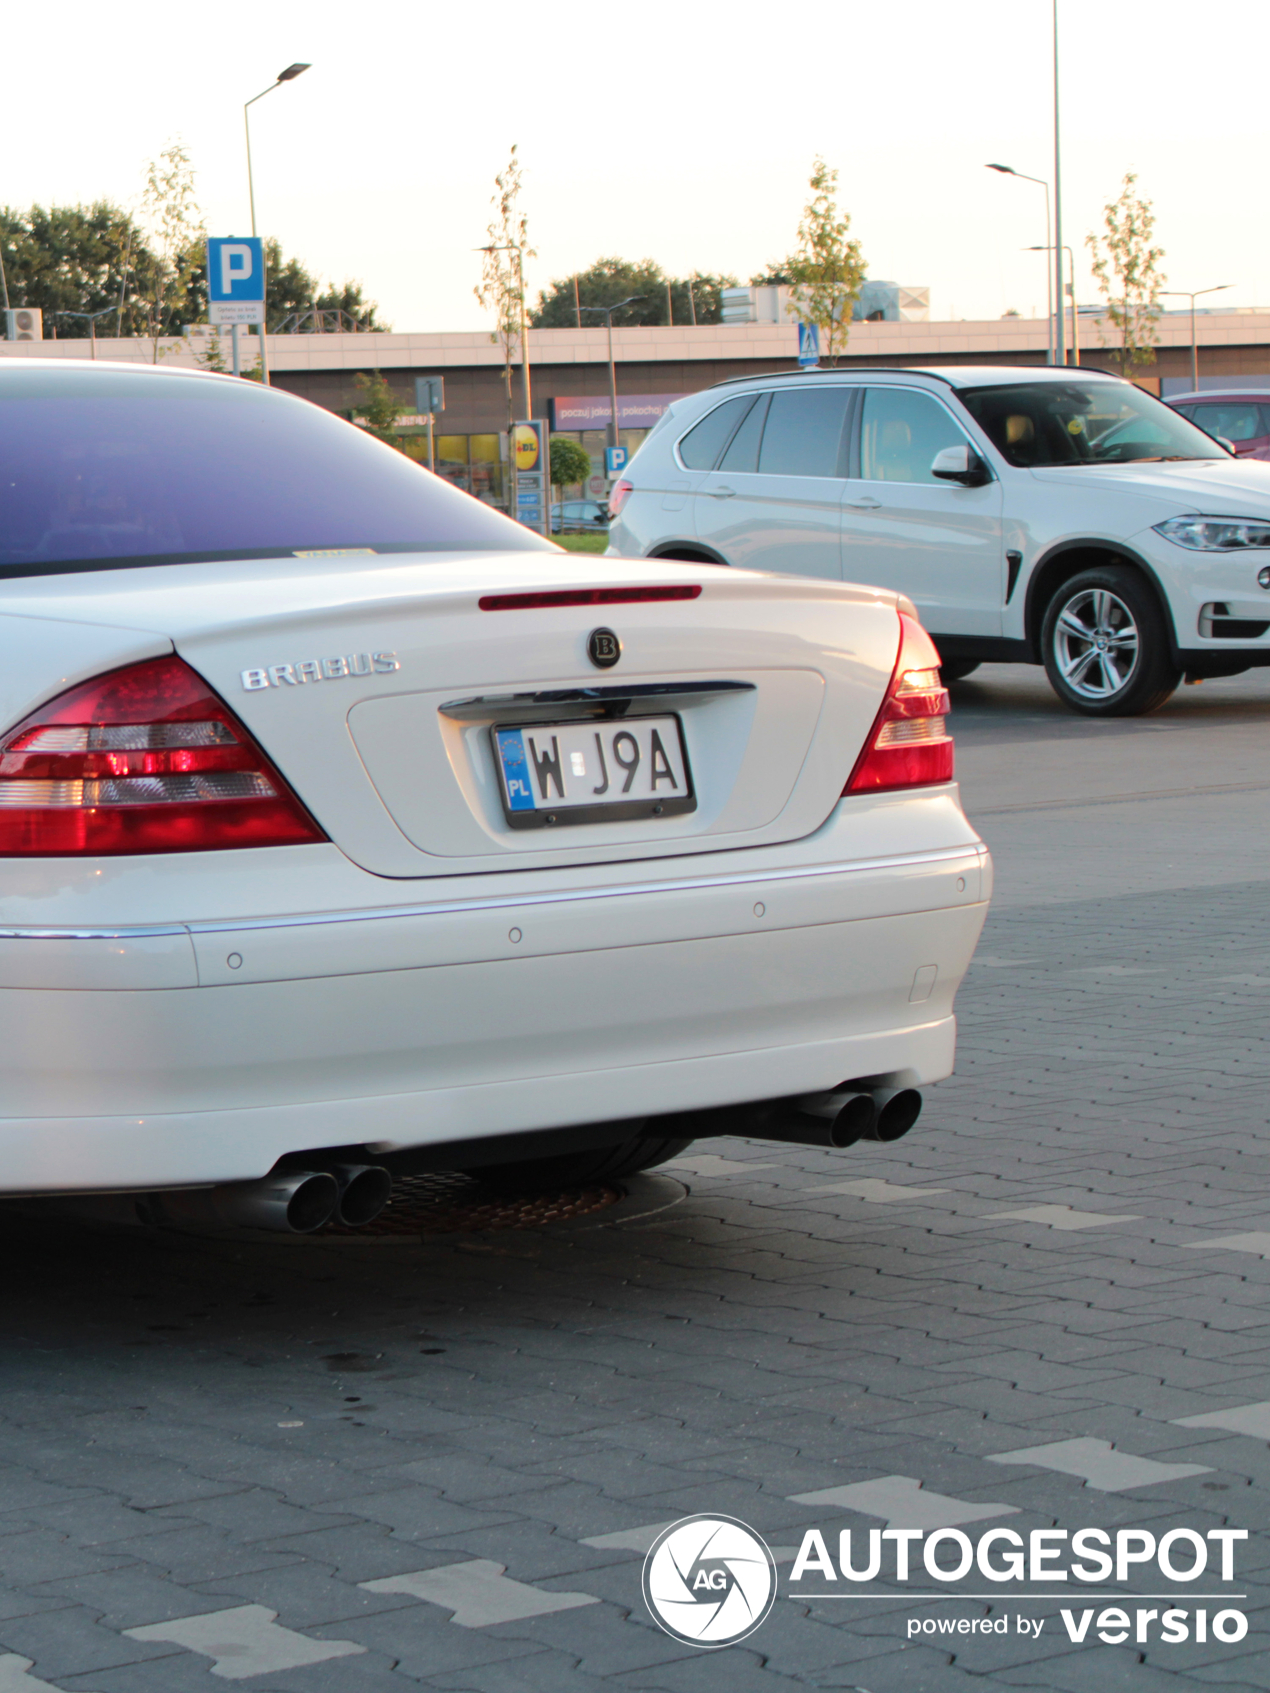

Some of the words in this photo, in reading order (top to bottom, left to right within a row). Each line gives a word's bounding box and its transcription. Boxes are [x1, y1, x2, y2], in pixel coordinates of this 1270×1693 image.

[221, 244, 252, 294] P
[561, 408, 590, 419] poczuj
[622, 405, 662, 417] pokochaj
[612, 449, 625, 469] P
[596, 634, 617, 659] B
[241, 651, 400, 692] BRABUS
[508, 779, 529, 797] PL
[528, 735, 566, 799] W
[592, 728, 679, 795] J9A
